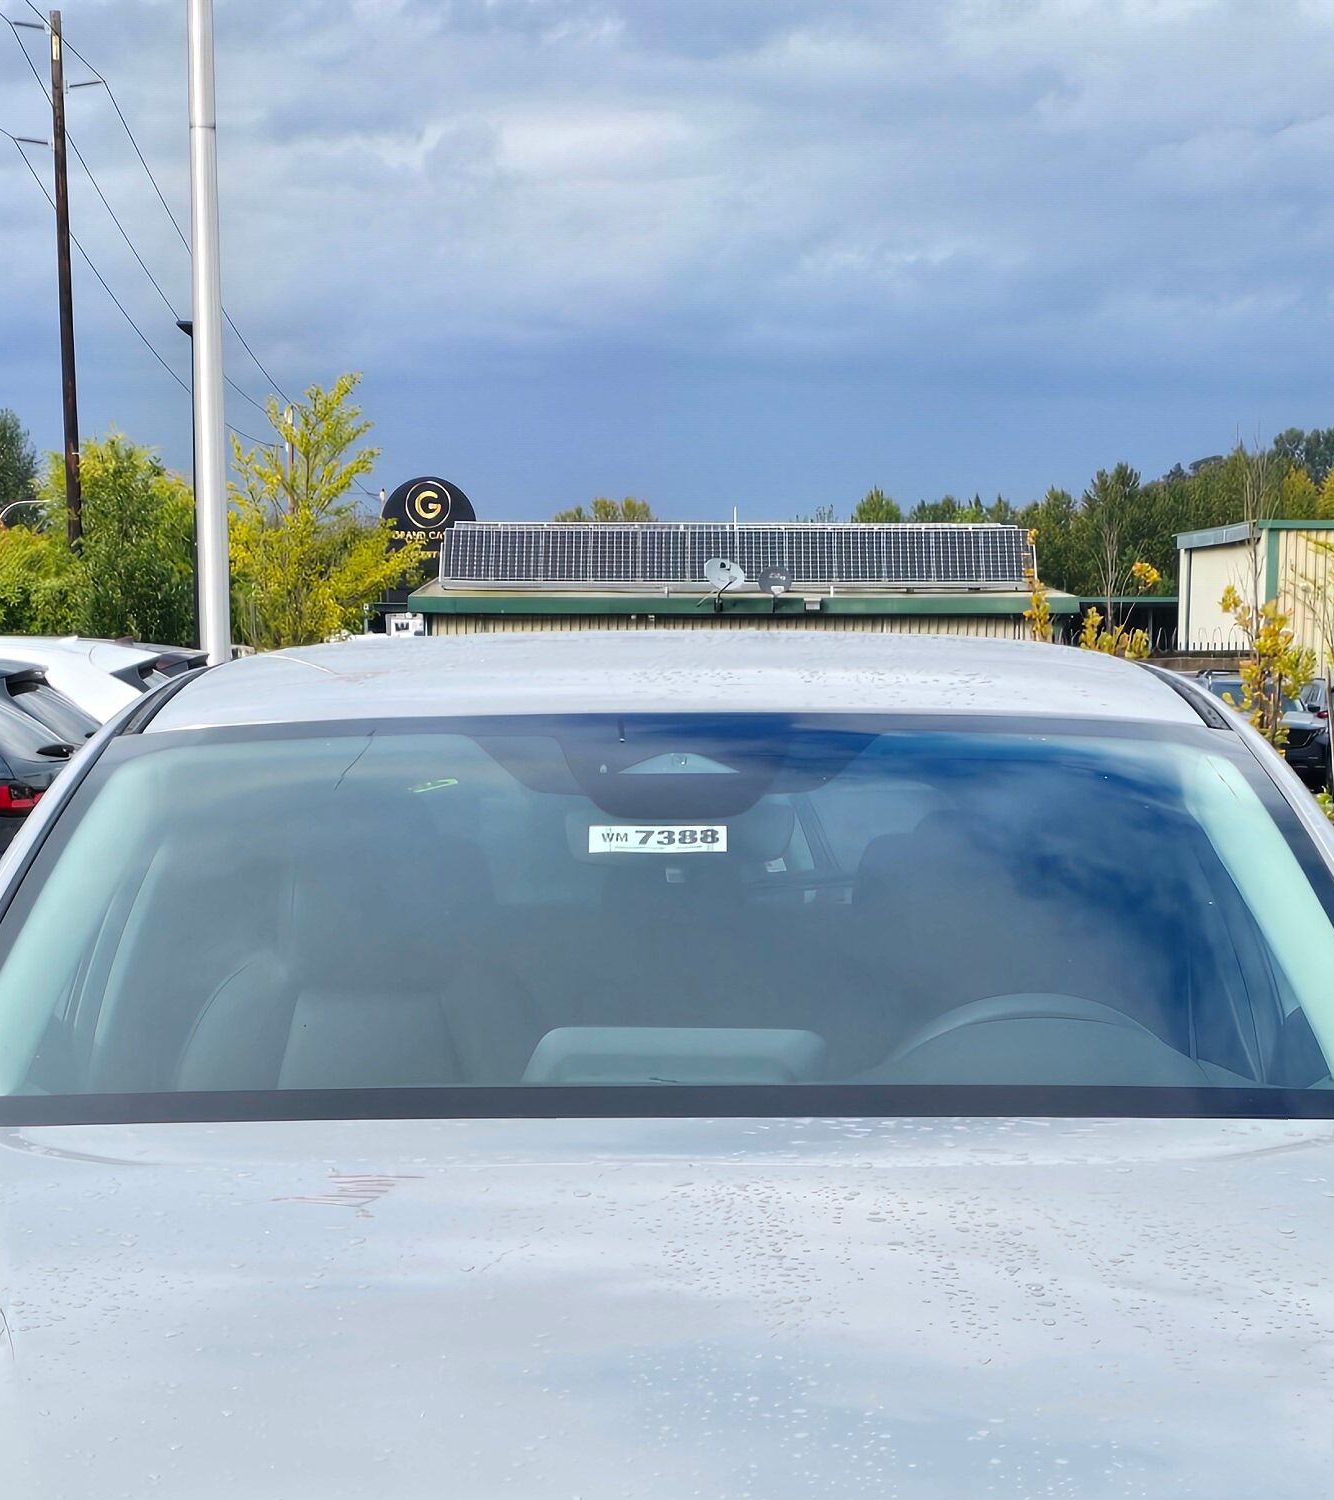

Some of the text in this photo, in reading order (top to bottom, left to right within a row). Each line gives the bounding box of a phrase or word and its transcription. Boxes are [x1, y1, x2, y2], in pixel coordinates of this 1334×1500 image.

[414, 490, 442, 519] G
[601, 829, 720, 845] WM 7388
